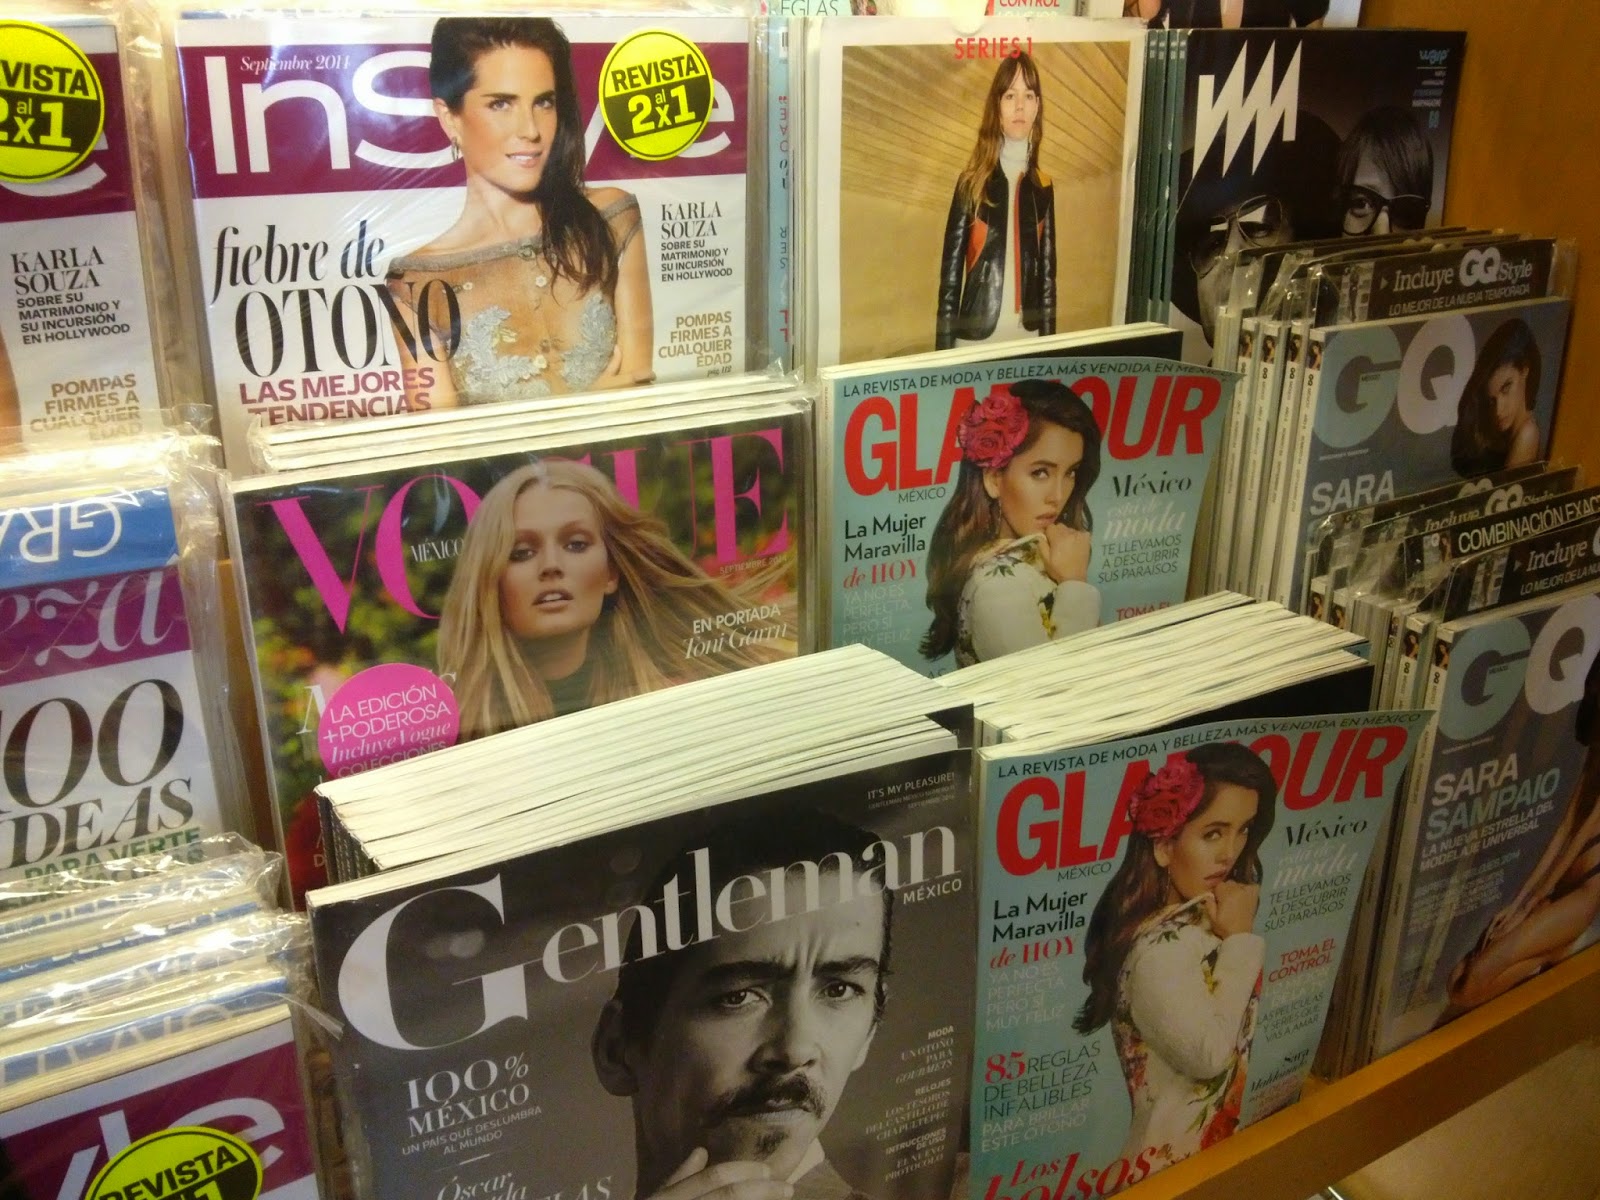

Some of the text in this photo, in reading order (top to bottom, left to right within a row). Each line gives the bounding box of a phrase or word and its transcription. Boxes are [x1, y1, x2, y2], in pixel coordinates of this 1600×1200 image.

[954, 37, 1033, 59] SERIES 1
[0, 60, 90, 97] VISTA
[240, 56, 313, 76] Septiembre
[611, 53, 700, 93] REVISTA
[16, 97, 32, 115] al
[654, 88, 667, 105] al
[661, 201, 722, 221] KARLA
[661, 219, 718, 240] SOUZA
[661, 239, 706, 251] SOBRE SU
[661, 248, 729, 262] MATRIMONIO Y
[11, 245, 104, 274] KARLA
[210, 219, 386, 305] fiebre de
[661, 257, 725, 272] SU INCURSIÓN
[1393, 246, 1533, 294] Incluye GQ Style
[14, 269, 102, 295] SOUZA
[661, 268, 733, 283] EN HOLLYWOOD
[17, 292, 84, 309] SOBRE SU
[19, 300, 121, 321] MATRIMONIO Y
[1389, 304, 1399, 316] LO
[1400, 300, 1432, 316] MEJOR
[20, 312, 117, 333] SU INCURSIÓN
[23, 323, 131, 345] EN HOLLYWOOD
[675, 311, 732, 329] POMPAS
[670, 326, 732, 344] FIRMES A
[658, 339, 732, 360] CUALQUIER
[696, 352, 732, 368] EDAD
[51, 373, 137, 398] POMPAS
[239, 367, 436, 405] LAS MEJORES
[843, 362, 1174, 397] LA REVISTA DE MODA Y BELLEZA MÁS VENDIDA EN
[1312, 313, 1476, 449] GQ
[45, 390, 139, 415] FIRMES A
[247, 392, 432, 426] TENDENCIAS
[843, 375, 1221, 497] GLAOUR
[899, 486, 946, 504] MÉXICO
[1113, 470, 1192, 498] México
[1309, 470, 1395, 516] SARA
[845, 513, 926, 540] La Mujer
[1458, 505, 1564, 553] COMBINACIÓN
[844, 534, 926, 562] Maravilla
[1102, 534, 1183, 556] TE LLEVAMOS
[1114, 547, 1180, 568] DESCUBRIR
[1526, 540, 1588, 572] Incluye
[843, 557, 920, 589] de HOY
[1098, 570, 1120, 584] SUS
[693, 603, 780, 634] EN PORTADA
[683, 635, 724, 659] Toni
[330, 705, 355, 724] LA
[358, 684, 437, 718] EDICIÓN
[323, 701, 451, 744] +PODEROSA
[0, 678, 184, 808] 00
[331, 722, 452, 764] Incluye Vogue
[999, 718, 1360, 778] LA REVISTA DE MODA Y BELLEZA MÁS VENDIDA EN
[888, 784, 902, 796] MY
[905, 772, 955, 791] PLEASURE!
[1432, 753, 1519, 807] SARA
[996, 724, 1408, 877] GLAOUR
[1426, 767, 1561, 842] SAMPAIO
[0, 777, 194, 871] DEAS
[1286, 815, 1369, 847] México
[1422, 800, 1555, 859] LA NUEVA ESTRELLA DEL
[1482, 818, 1540, 849] UNIVERSAL
[1057, 862, 1112, 883] MÉXICO
[903, 878, 962, 905] MÉXICO
[1281, 886, 1349, 915] DESCUBRIR
[1286, 873, 1352, 901] LLEVAMOS
[993, 891, 1088, 920] La Mujer
[337, 826, 962, 1052] Gentleman
[992, 911, 1086, 943] Maravilla
[1264, 918, 1285, 933] SUS
[990, 947, 1016, 970] de
[1280, 938, 1336, 966] TOMA EL
[1268, 953, 1333, 983] CONTROL
[928, 1025, 954, 1040] MODA
[985, 1041, 1101, 1085] 85 REGLAS
[406, 1058, 498, 1112] 100
[915, 1078, 951, 1097] RELOJES
[984, 1061, 1099, 1103] DE BELLEZA
[408, 1082, 530, 1139] MÉXICO
[984, 1079, 1093, 1122] INFALIBLES
[402, 1106, 542, 1155] UN PAÍS QUE DESLUMBRA
[443, 1131, 503, 1156] AL MUNDO
[981, 1134, 1020, 1153] ESTE
[1010, 1157, 1063, 1187] Los
